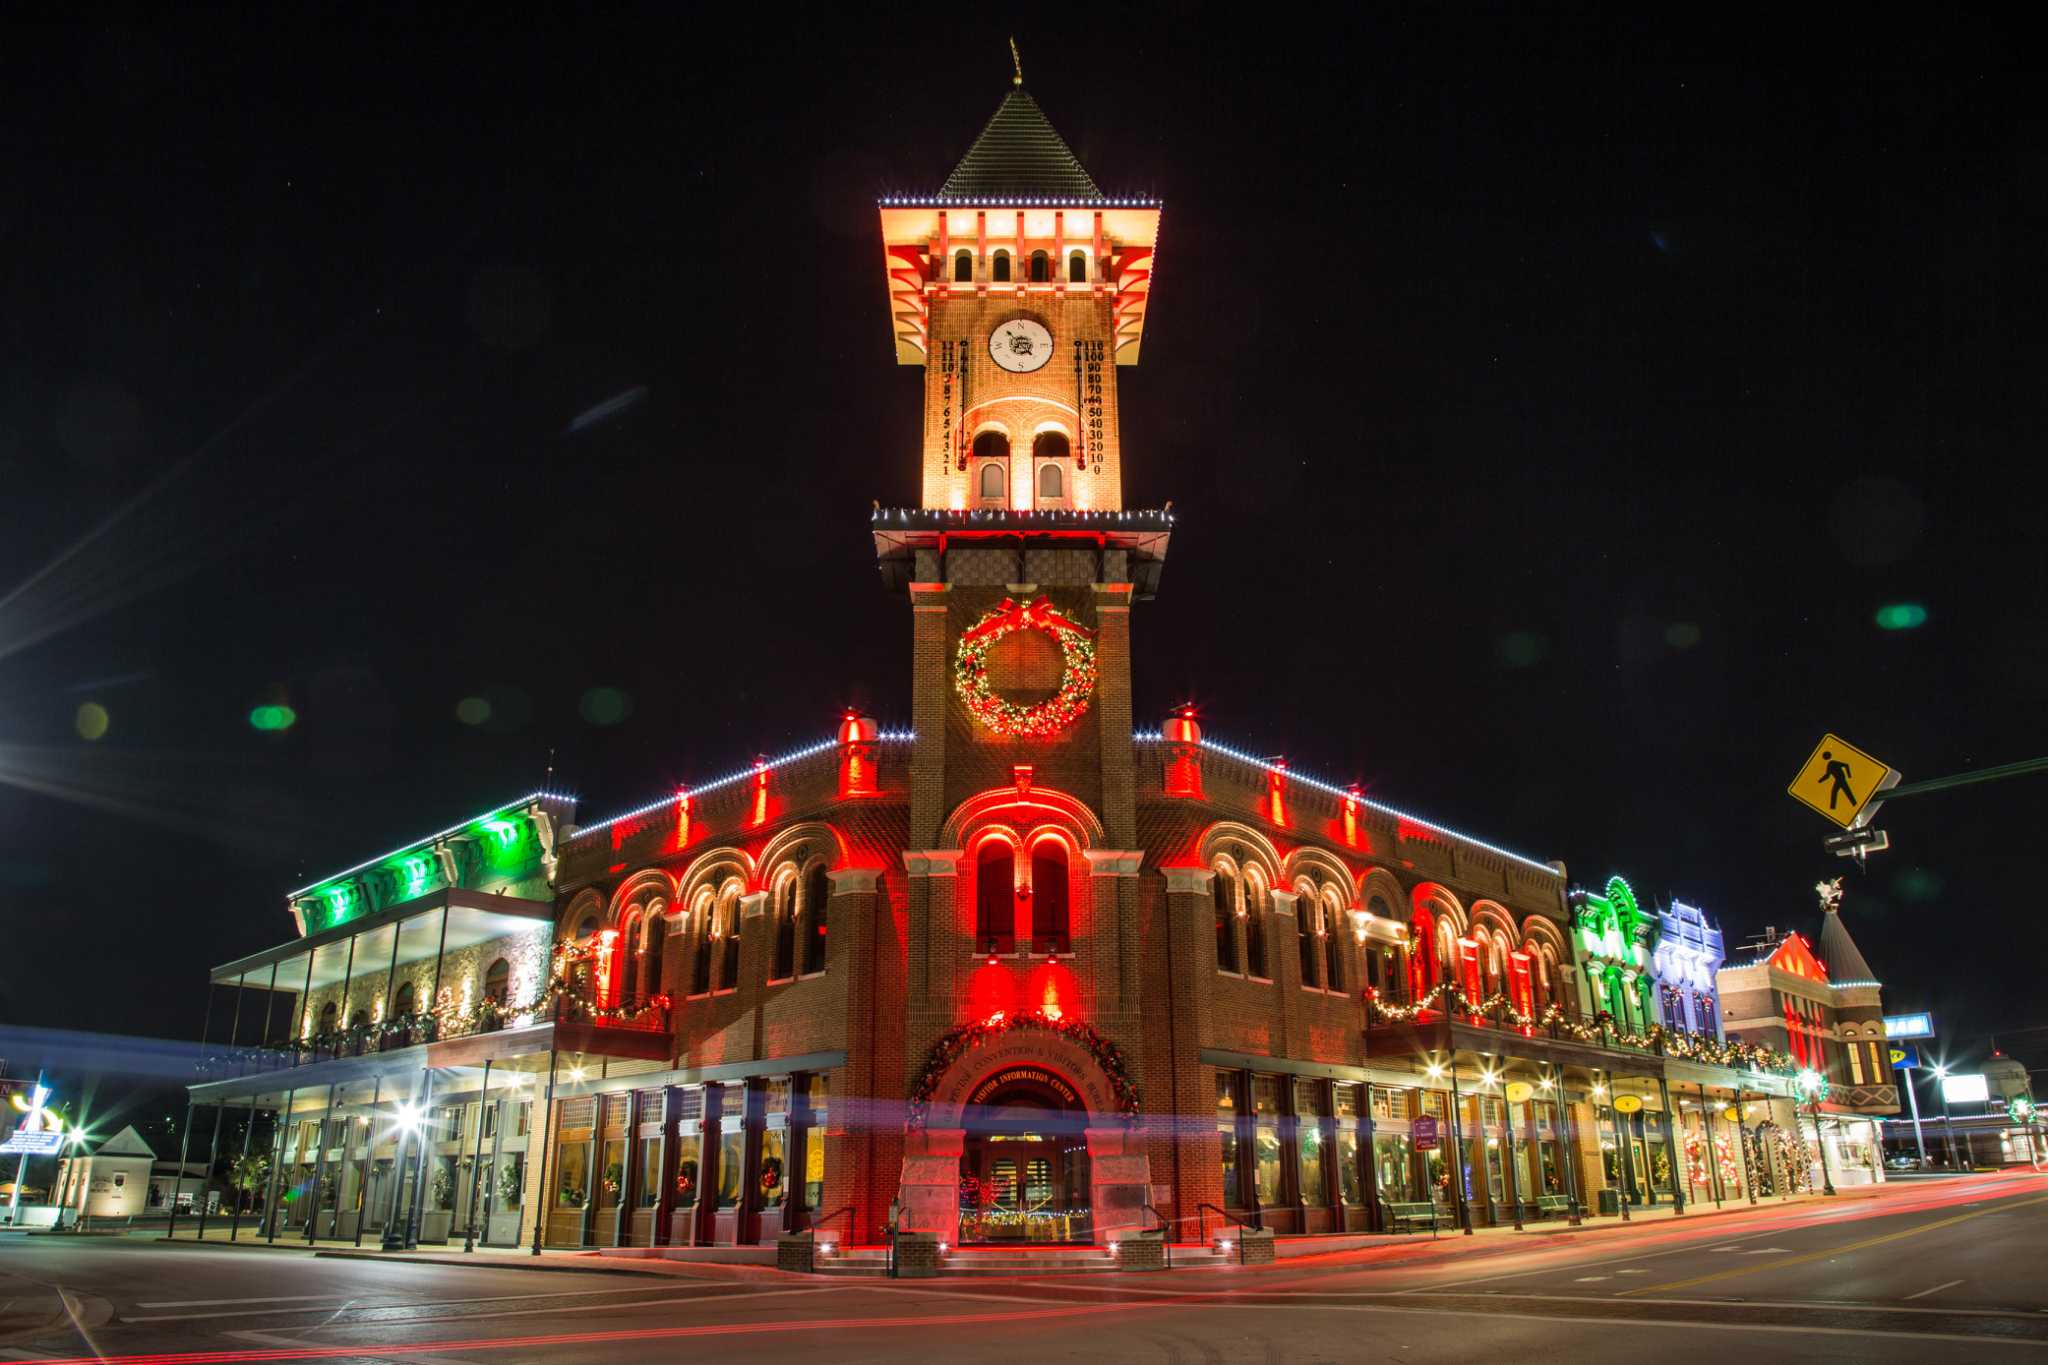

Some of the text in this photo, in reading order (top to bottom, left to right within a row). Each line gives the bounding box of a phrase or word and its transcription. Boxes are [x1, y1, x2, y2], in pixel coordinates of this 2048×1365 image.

[1017, 321, 1025, 330] N
[1085, 340, 1104, 351] 110
[1085, 351, 1104, 361] 100
[942, 362, 954, 372] 10
[1018, 361, 1025, 369] S
[1088, 362, 1101, 372] 90
[1088, 373, 1101, 384] 80
[1088, 384, 1102, 395] 70
[944, 407, 951, 417] 6
[1089, 407, 1103, 417] 50
[1089, 418, 1103, 429] 40
[1089, 429, 1103, 440] 30
[1090, 441, 1104, 452] 20
[1091, 453, 1104, 463] 10
[1094, 465, 1101, 475] 0
[974, 1071, 1075, 1104] VISITOR INFORMATION CENTER
